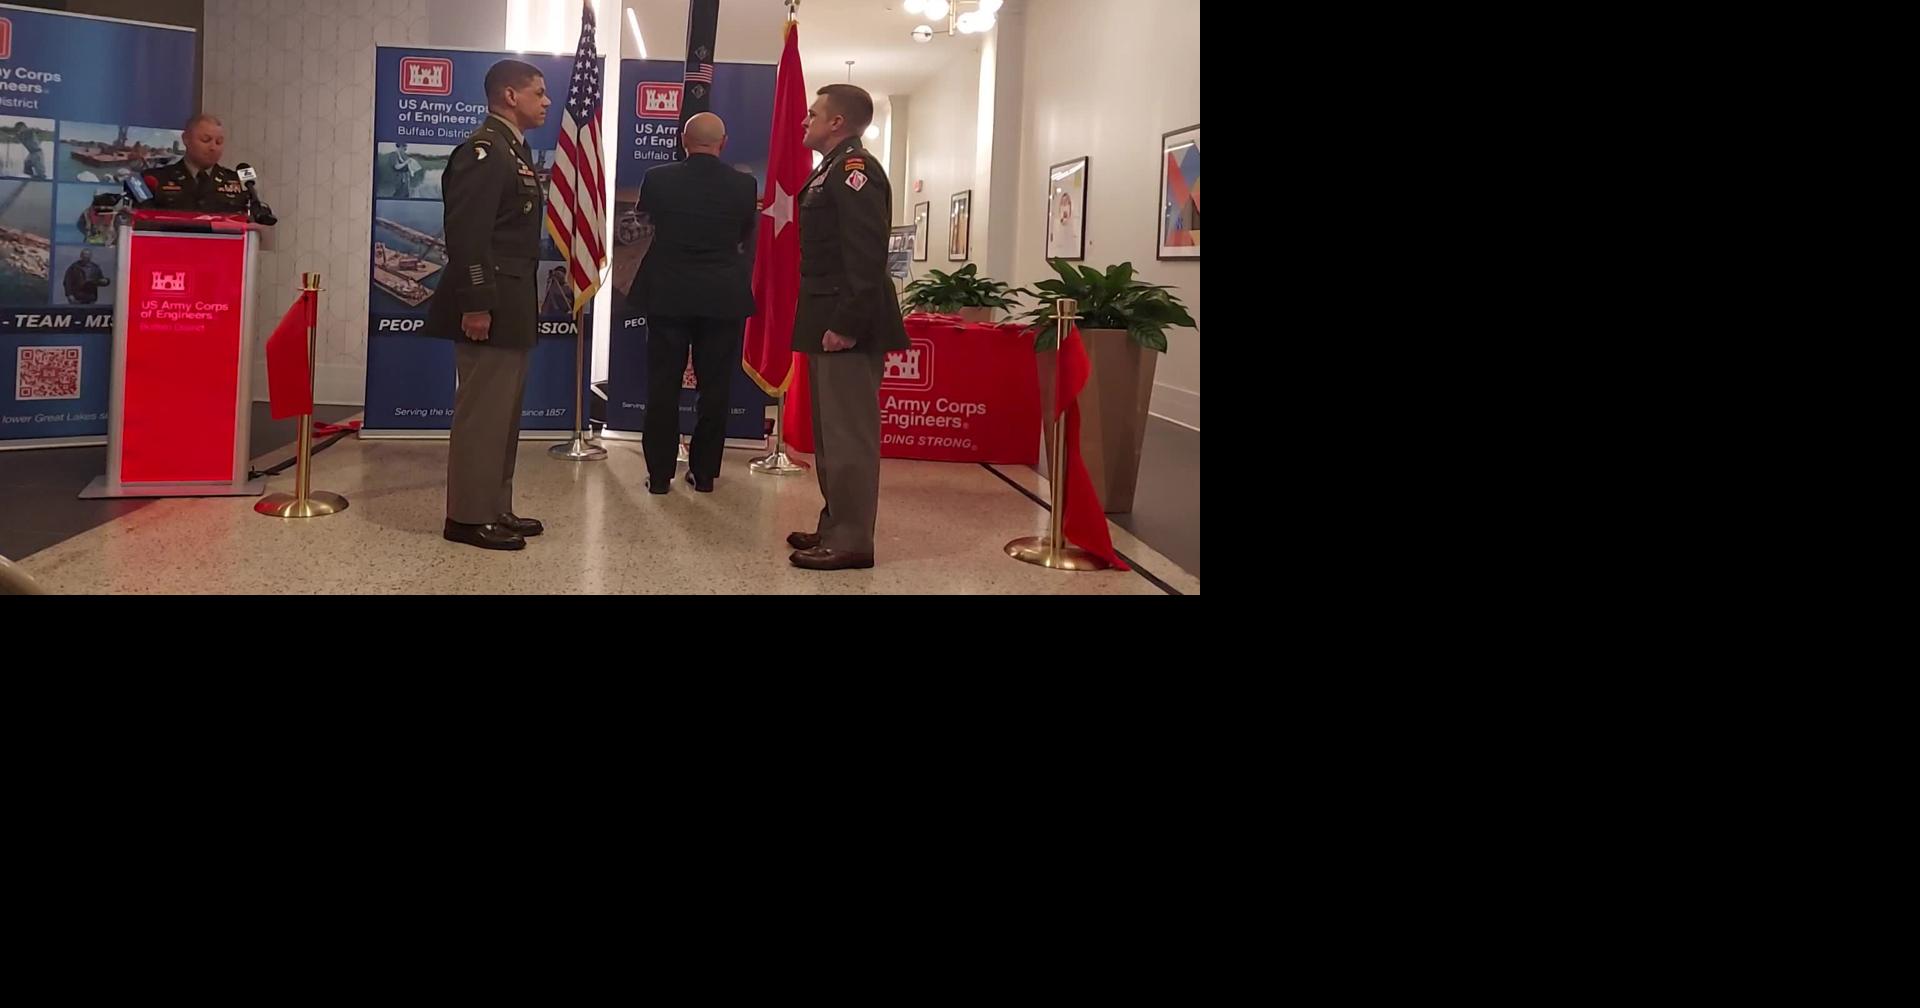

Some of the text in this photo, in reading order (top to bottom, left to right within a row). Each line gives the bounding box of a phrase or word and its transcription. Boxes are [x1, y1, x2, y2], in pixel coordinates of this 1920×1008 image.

[15, 67, 62, 83] Corps
[399, 99, 417, 110] US
[420, 100, 453, 114] Army
[398, 111, 477, 125] of Engineers
[398, 126, 434, 137] Buffalo
[635, 123, 653, 134] US
[635, 135, 648, 146] of
[634, 150, 669, 161] Buffalo
[142, 300, 229, 313] US Army Corps
[15, 314, 72, 328] TEAM
[140, 309, 213, 321] of Engineers
[394, 407, 428, 418] Serving
[430, 408, 444, 416] the
[885, 395, 987, 418] Army Corps
[2, 415, 32, 424] lower
[917, 435, 972, 449] STRONG
